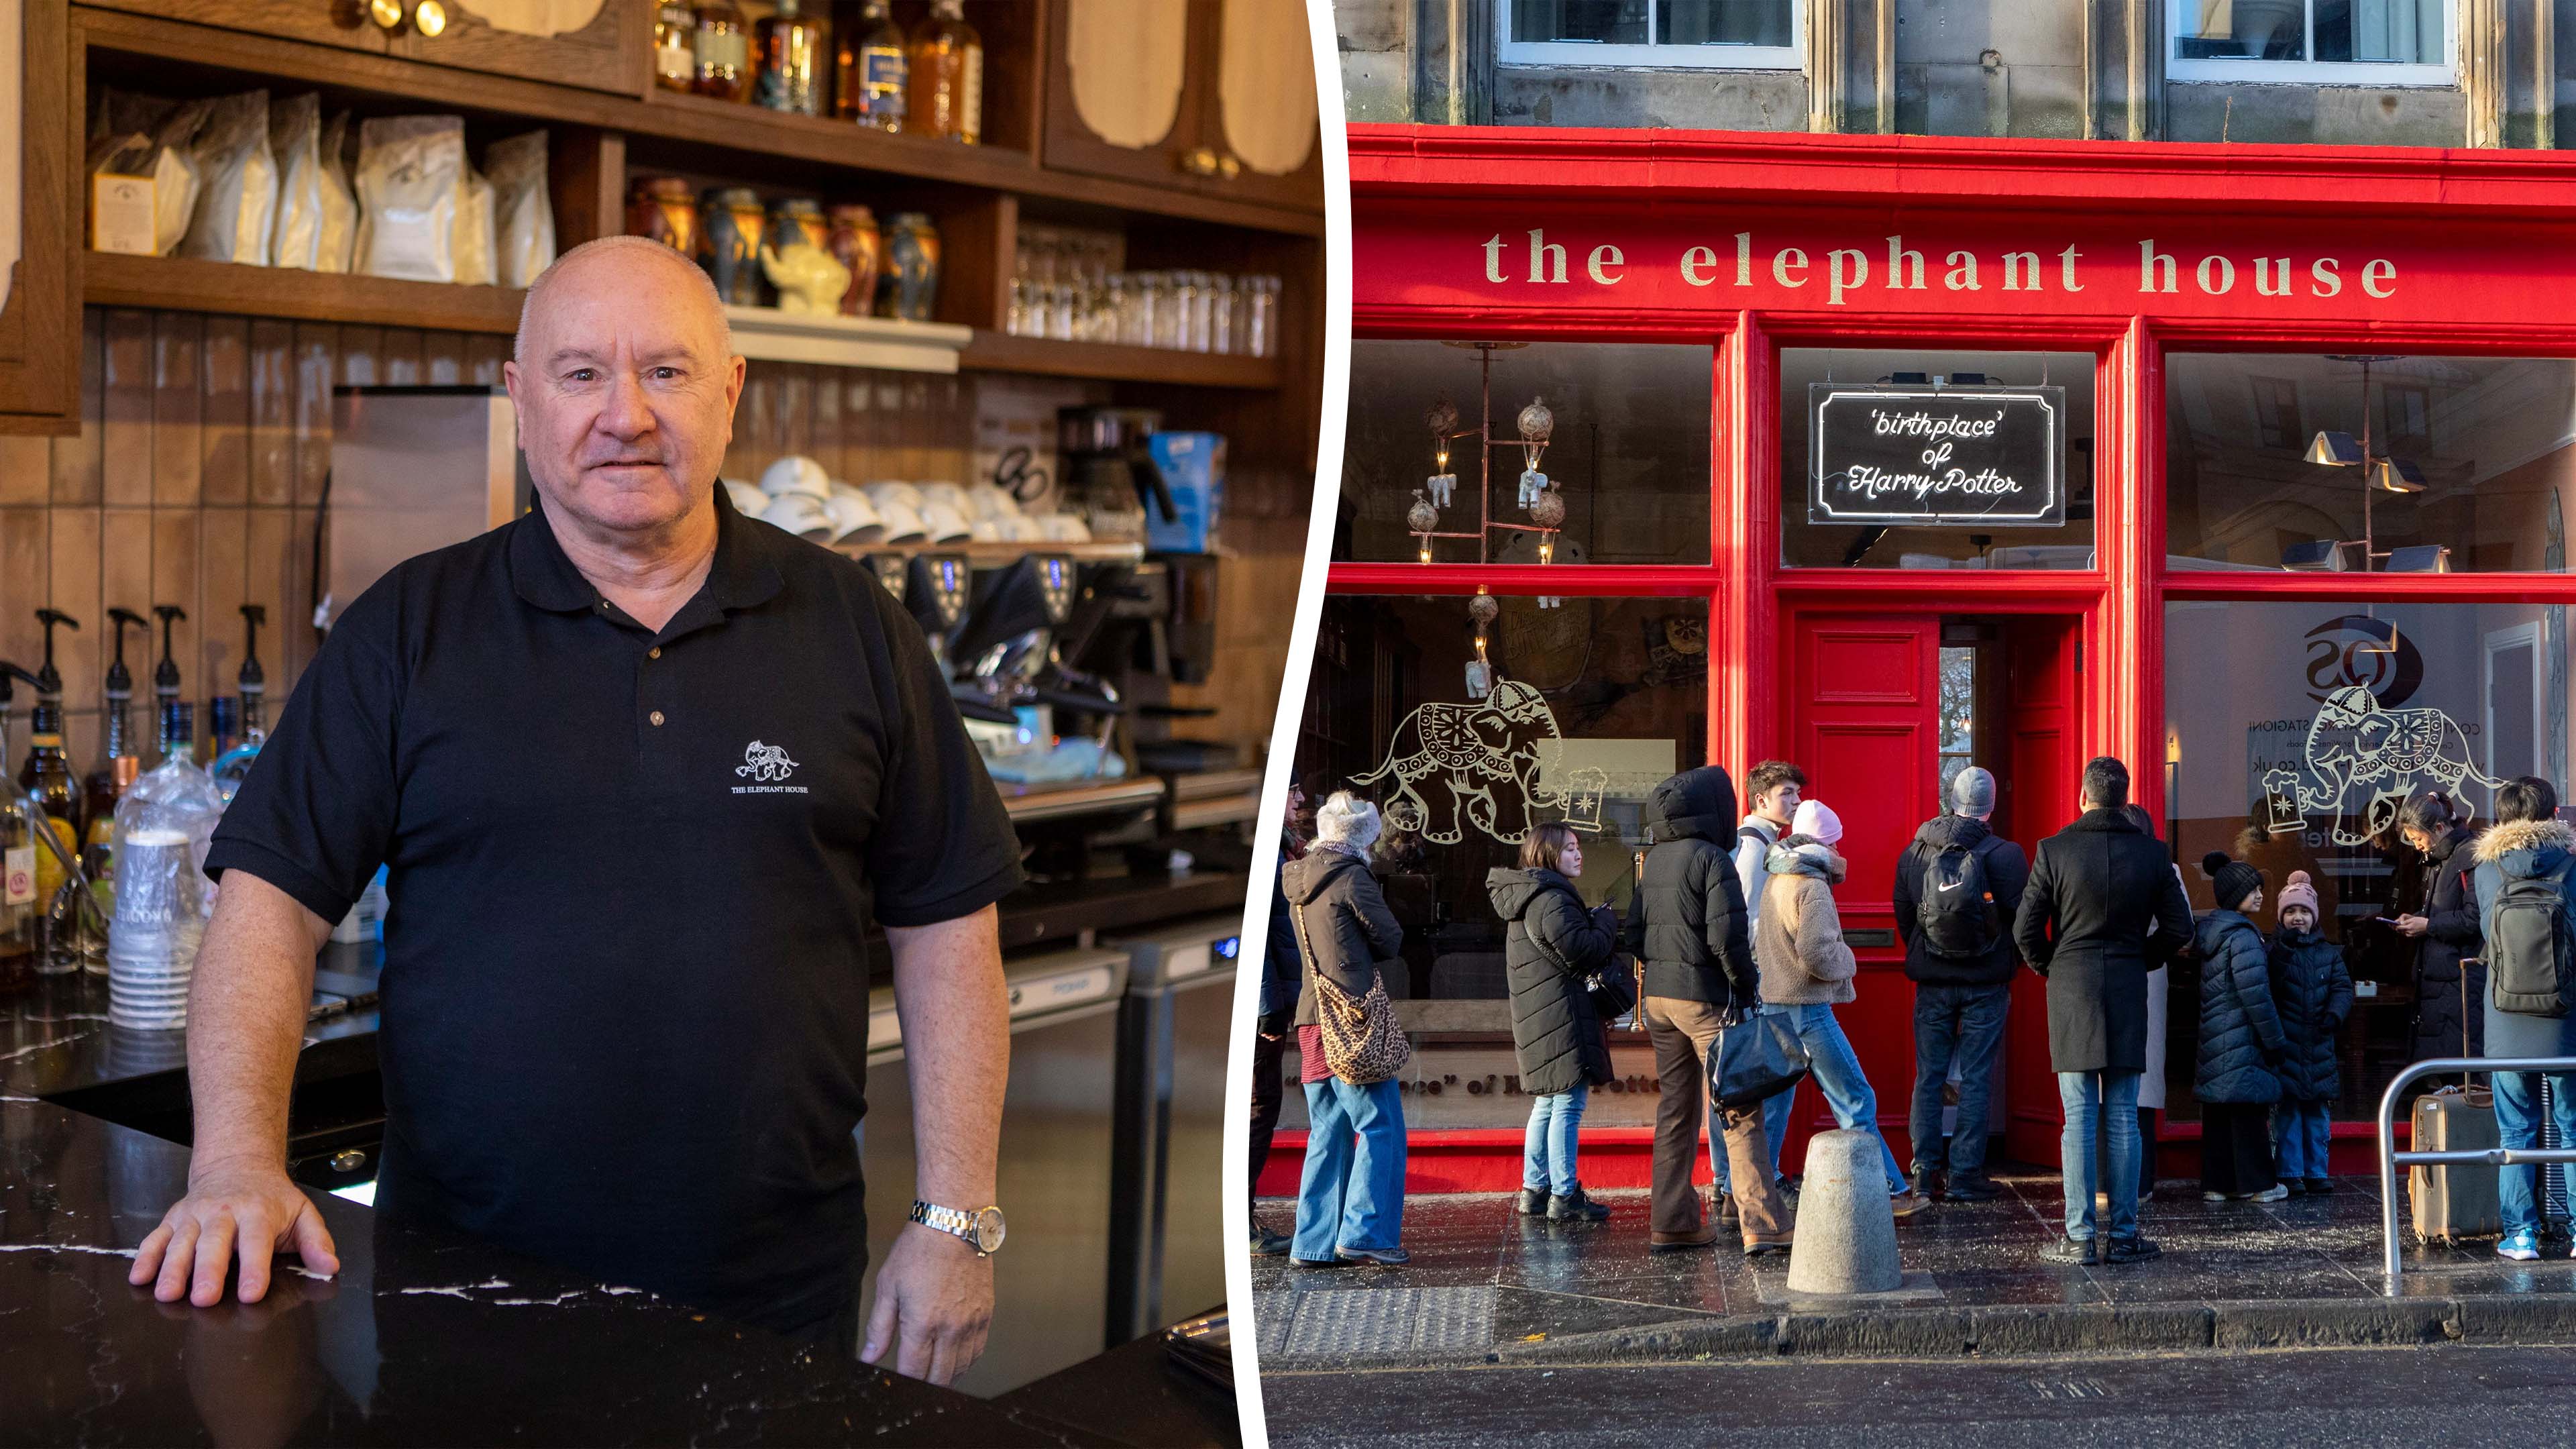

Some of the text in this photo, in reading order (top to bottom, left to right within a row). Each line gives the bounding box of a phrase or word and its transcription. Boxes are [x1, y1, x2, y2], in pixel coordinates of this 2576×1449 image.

[1481, 228, 2397, 305] the elephant house
[1921, 442, 1953, 470] of
[1848, 464, 2023, 500] Harry Potter
